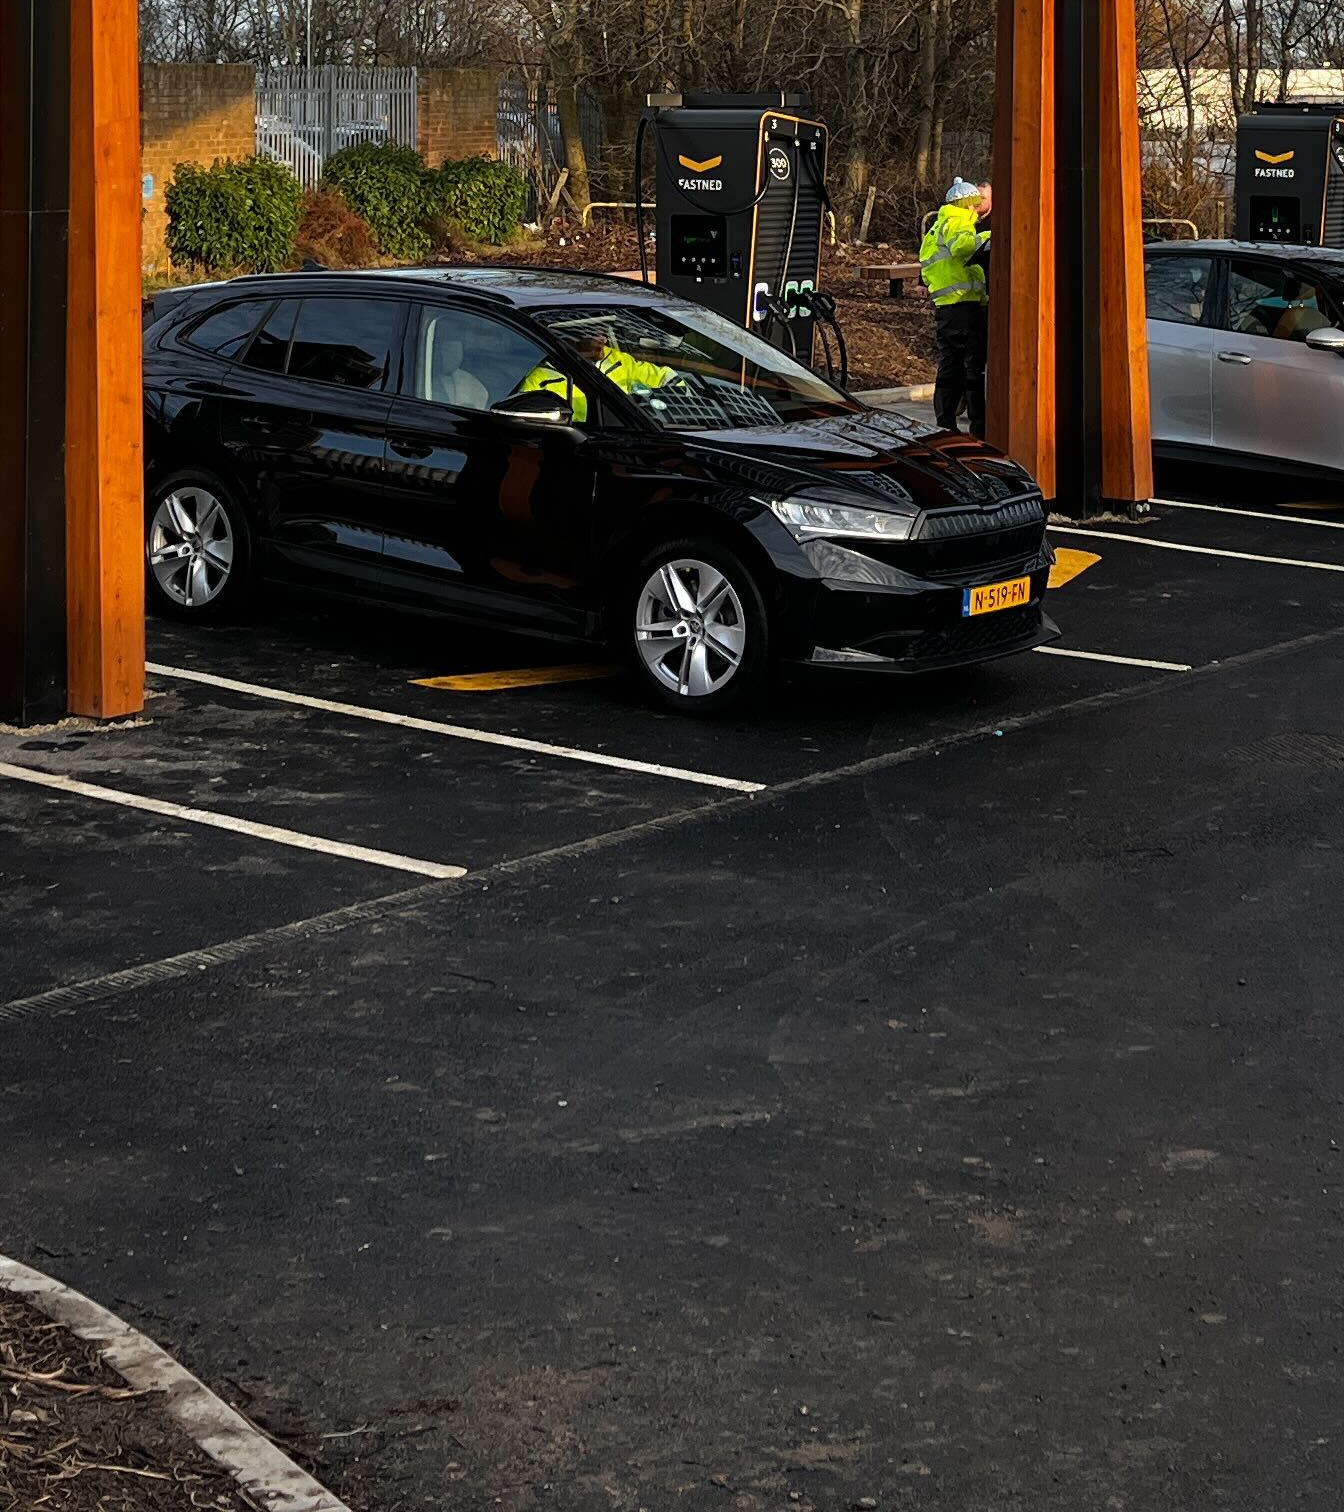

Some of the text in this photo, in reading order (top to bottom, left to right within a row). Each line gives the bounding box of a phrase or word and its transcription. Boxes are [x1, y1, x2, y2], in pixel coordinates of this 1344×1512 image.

[771, 118, 777, 130] 3
[815, 128, 821, 139] 4
[769, 157, 787, 169] 300
[1254, 167, 1295, 178] FASTNED
[678, 178, 723, 191] FASTNED
[974, 581, 1027, 611] N-519-FN
